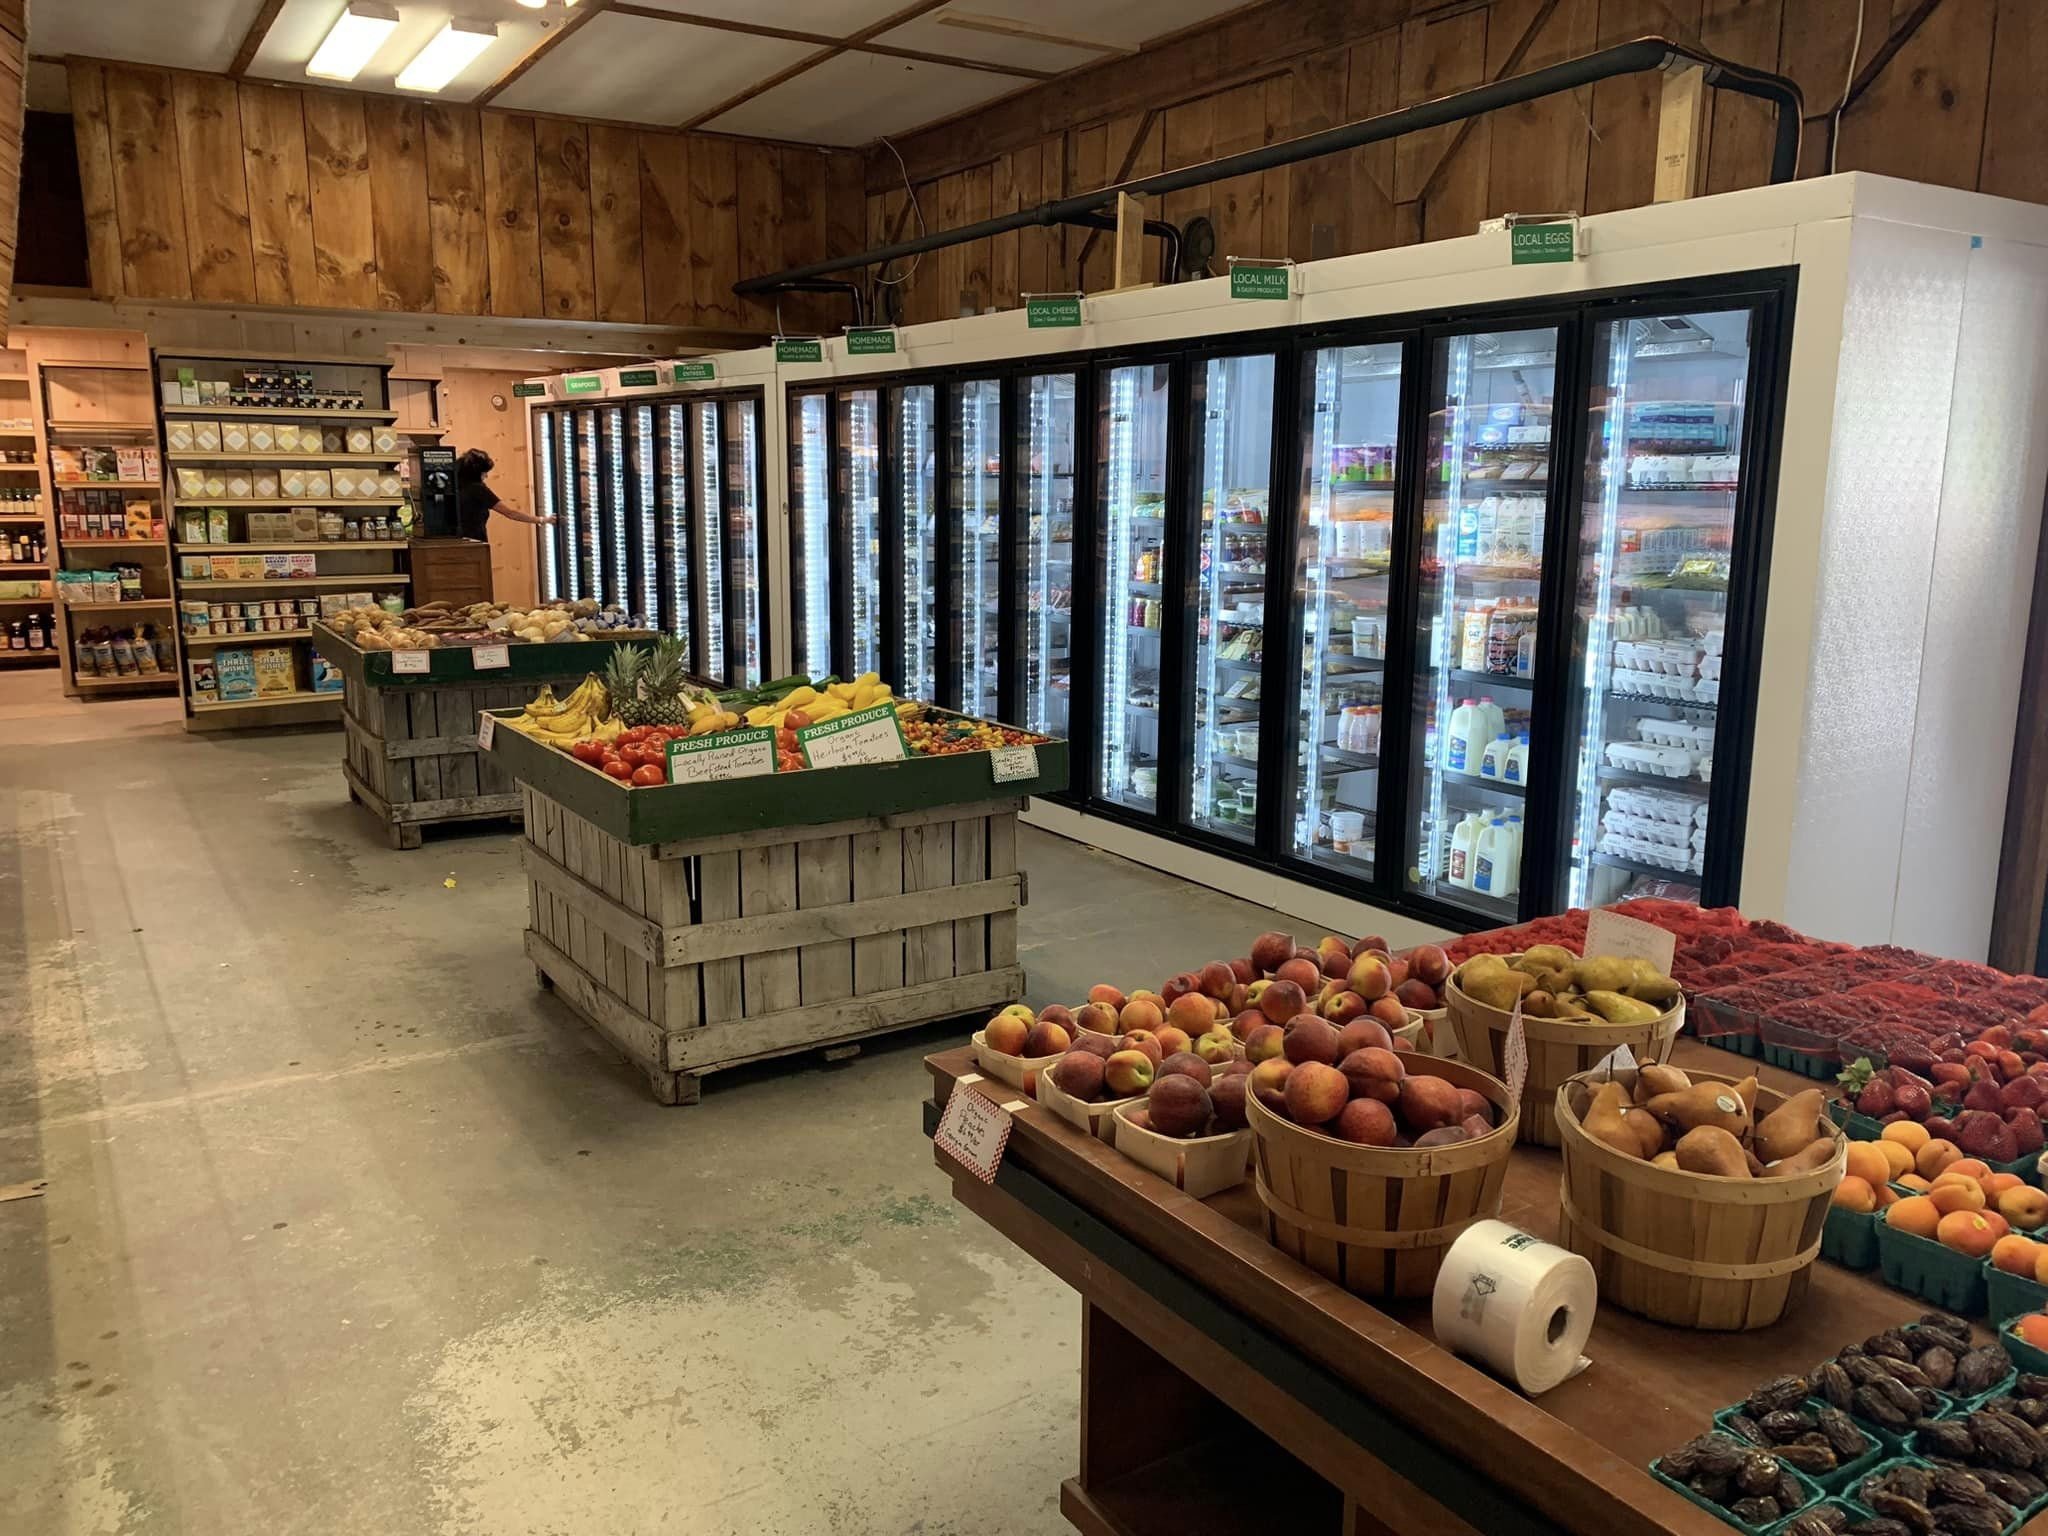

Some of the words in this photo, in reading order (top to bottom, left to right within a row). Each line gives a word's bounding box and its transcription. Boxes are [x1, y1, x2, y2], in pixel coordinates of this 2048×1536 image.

[1513, 233, 1543, 247] LOCAL
[1545, 231, 1571, 245] EGGS
[1233, 273, 1262, 285] LOCAL
[1263, 274, 1286, 286] MILK
[1029, 307, 1050, 315] LOCAL
[1052, 305, 1078, 315] CHEESE
[849, 335, 893, 345] HOMEMADE
[778, 345, 819, 354] HOMEMADE
[804, 721, 839, 739] FRESH
[841, 707, 889, 728] PRODUCE
[673, 738, 712, 752] FRESH
[716, 730, 769, 745] PRODUCE
